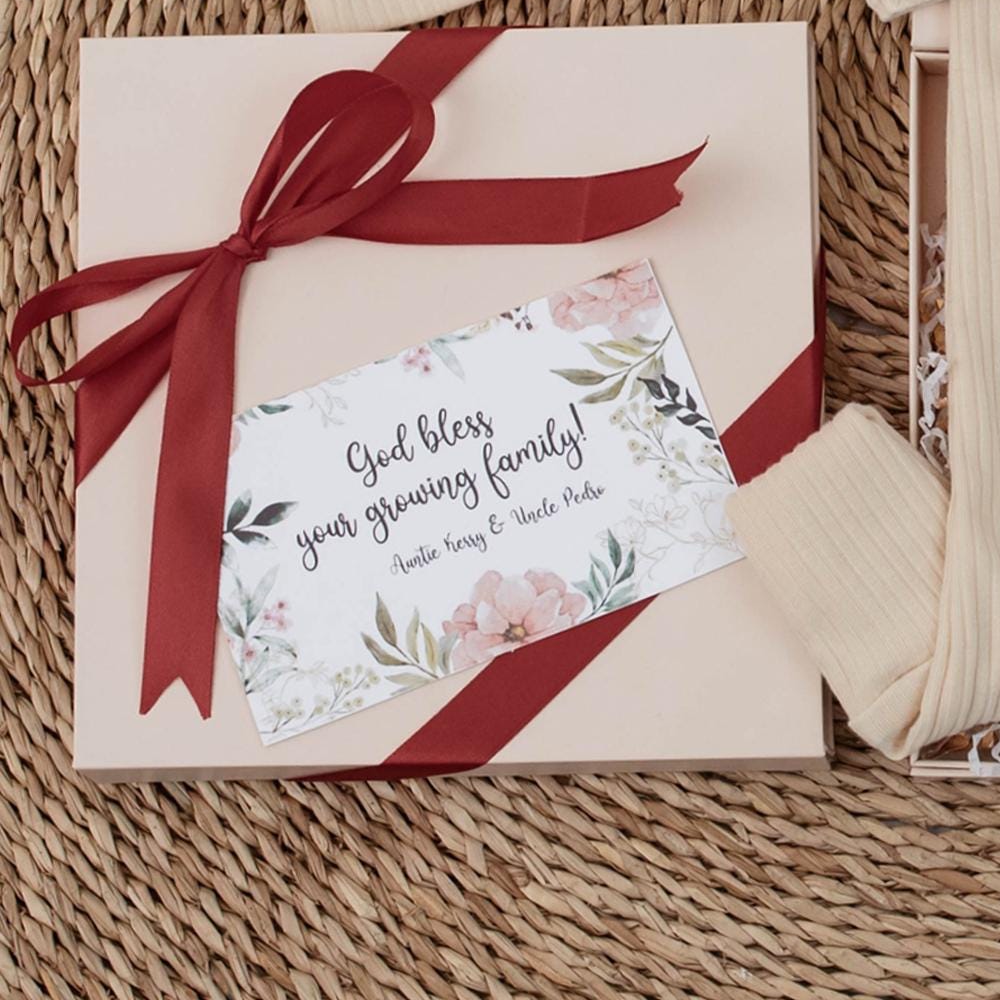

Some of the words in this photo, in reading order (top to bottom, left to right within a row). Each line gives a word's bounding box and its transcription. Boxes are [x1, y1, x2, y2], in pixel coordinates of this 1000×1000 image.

[296, 512, 358, 572] your
[365, 468, 479, 545] growing
[482, 402, 588, 500] family!
[346, 423, 414, 488] God
[417, 408, 494, 454] bless
[390, 545, 441, 575] Auntie
[443, 532, 488, 553] Kerry
[488, 513, 505, 535] &
[510, 497, 559, 526] Uncle
[562, 480, 606, 508] Pedro
